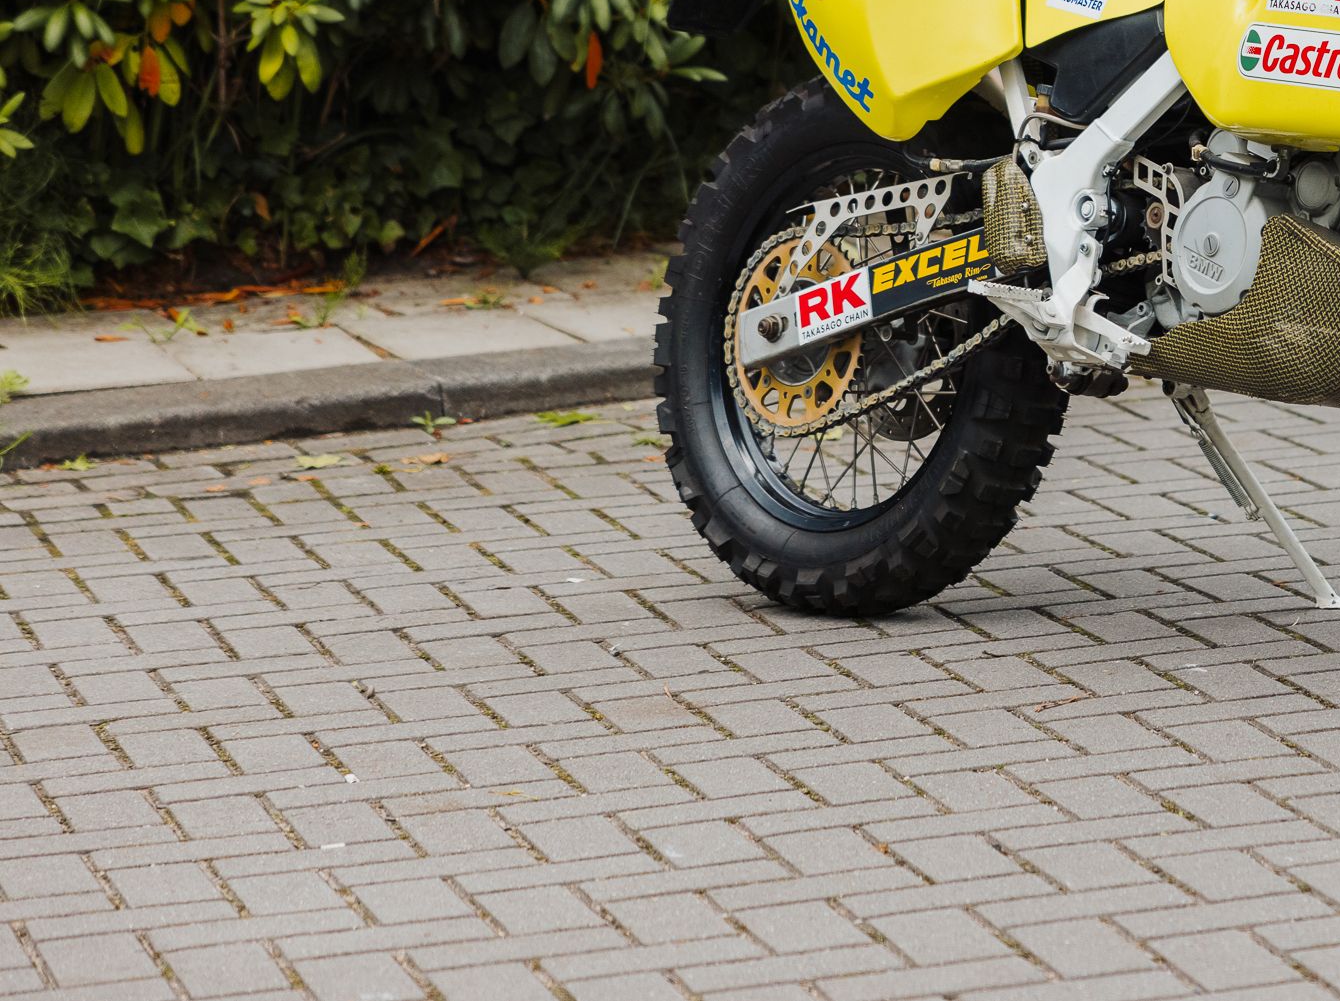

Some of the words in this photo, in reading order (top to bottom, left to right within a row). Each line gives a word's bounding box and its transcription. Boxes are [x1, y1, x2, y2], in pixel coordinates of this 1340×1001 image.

[871, 234, 990, 295] EXCEL
[926, 271, 963, 289] Takasago
[964, 264, 987, 283] Rim
[1188, 254, 1224, 282] BMW
[798, 272, 866, 329] RK
[801, 319, 842, 340] TAKASAGO
[844, 308, 869, 325] CHAIN
